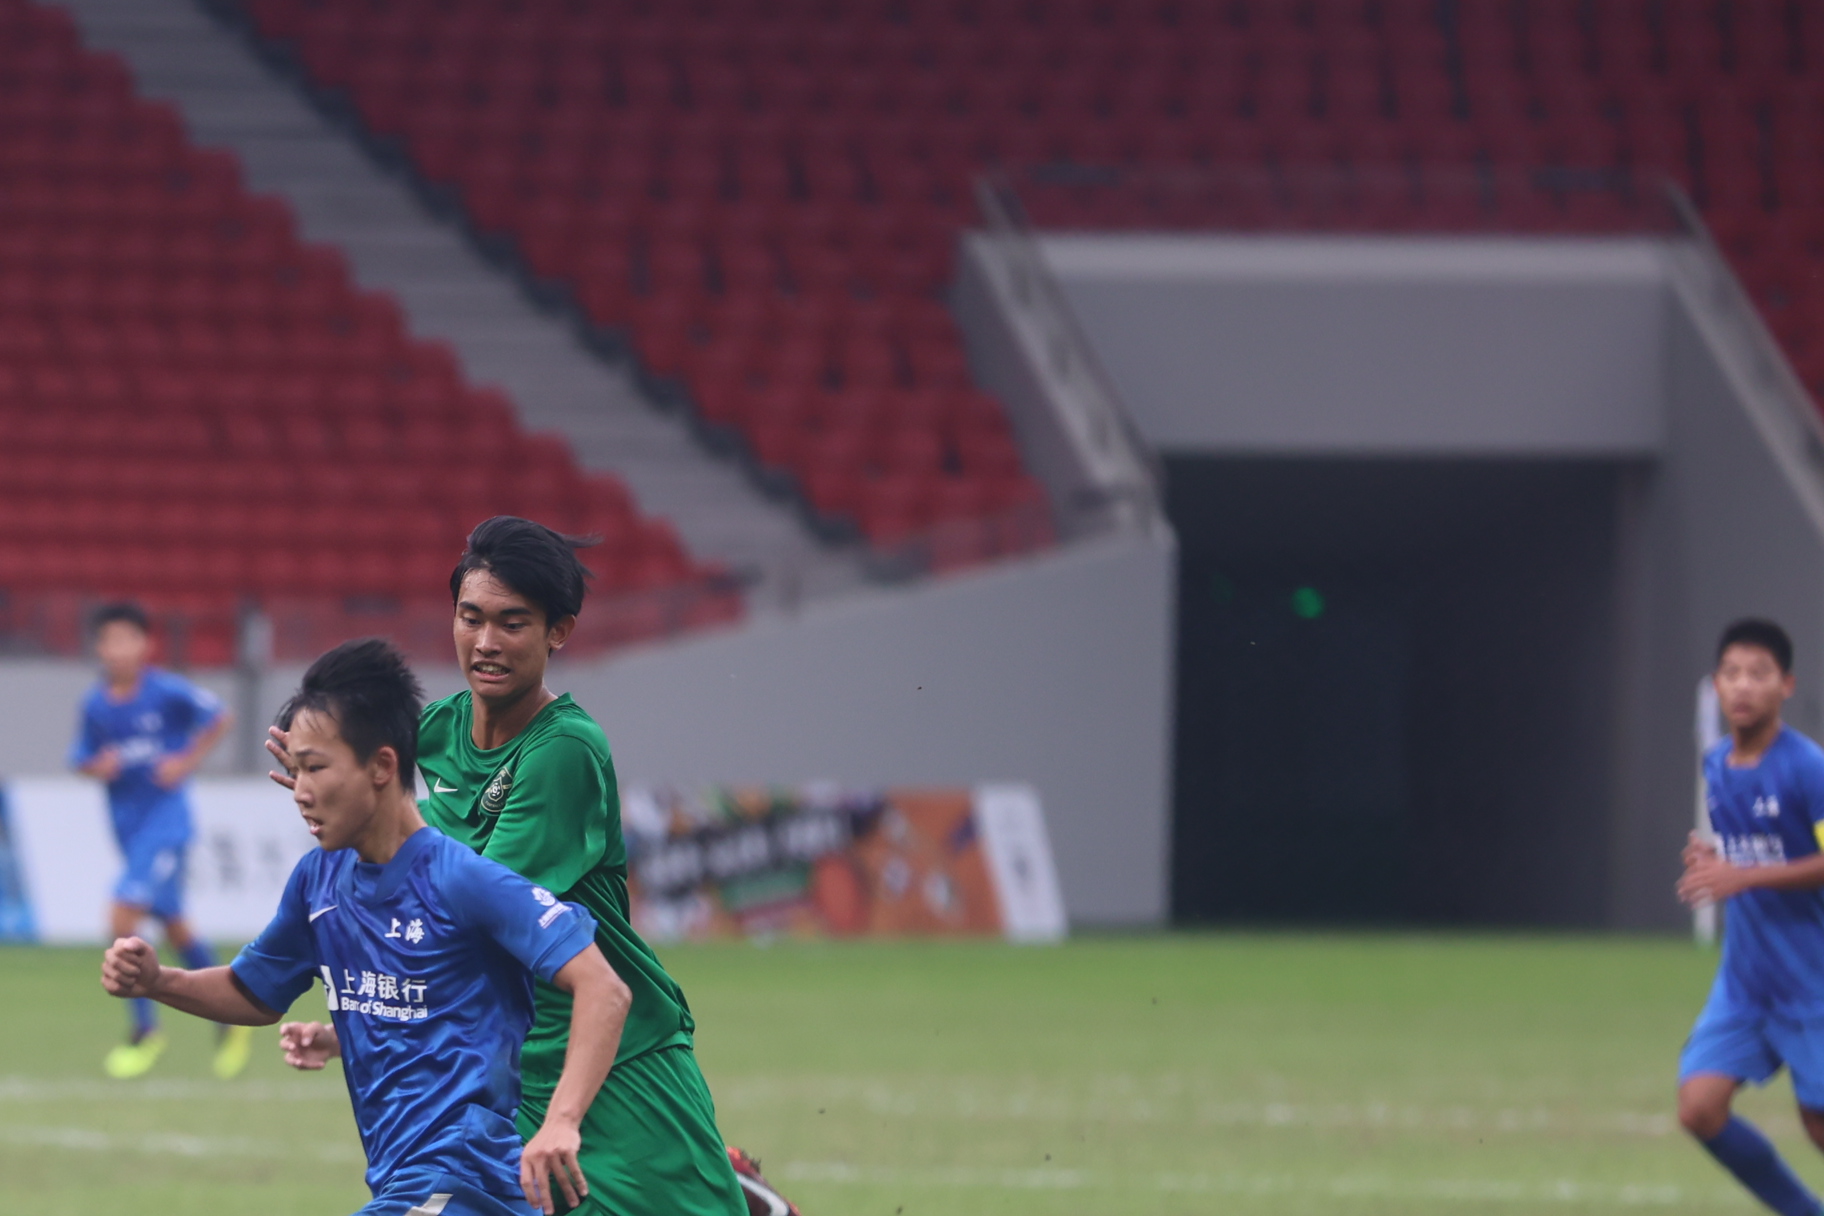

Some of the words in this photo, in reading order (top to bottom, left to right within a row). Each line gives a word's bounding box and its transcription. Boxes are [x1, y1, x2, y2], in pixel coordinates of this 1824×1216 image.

[384, 917, 425, 944] 上海
[340, 968, 428, 1003] 上海银行
[371, 1000, 428, 1022] Shanghai
